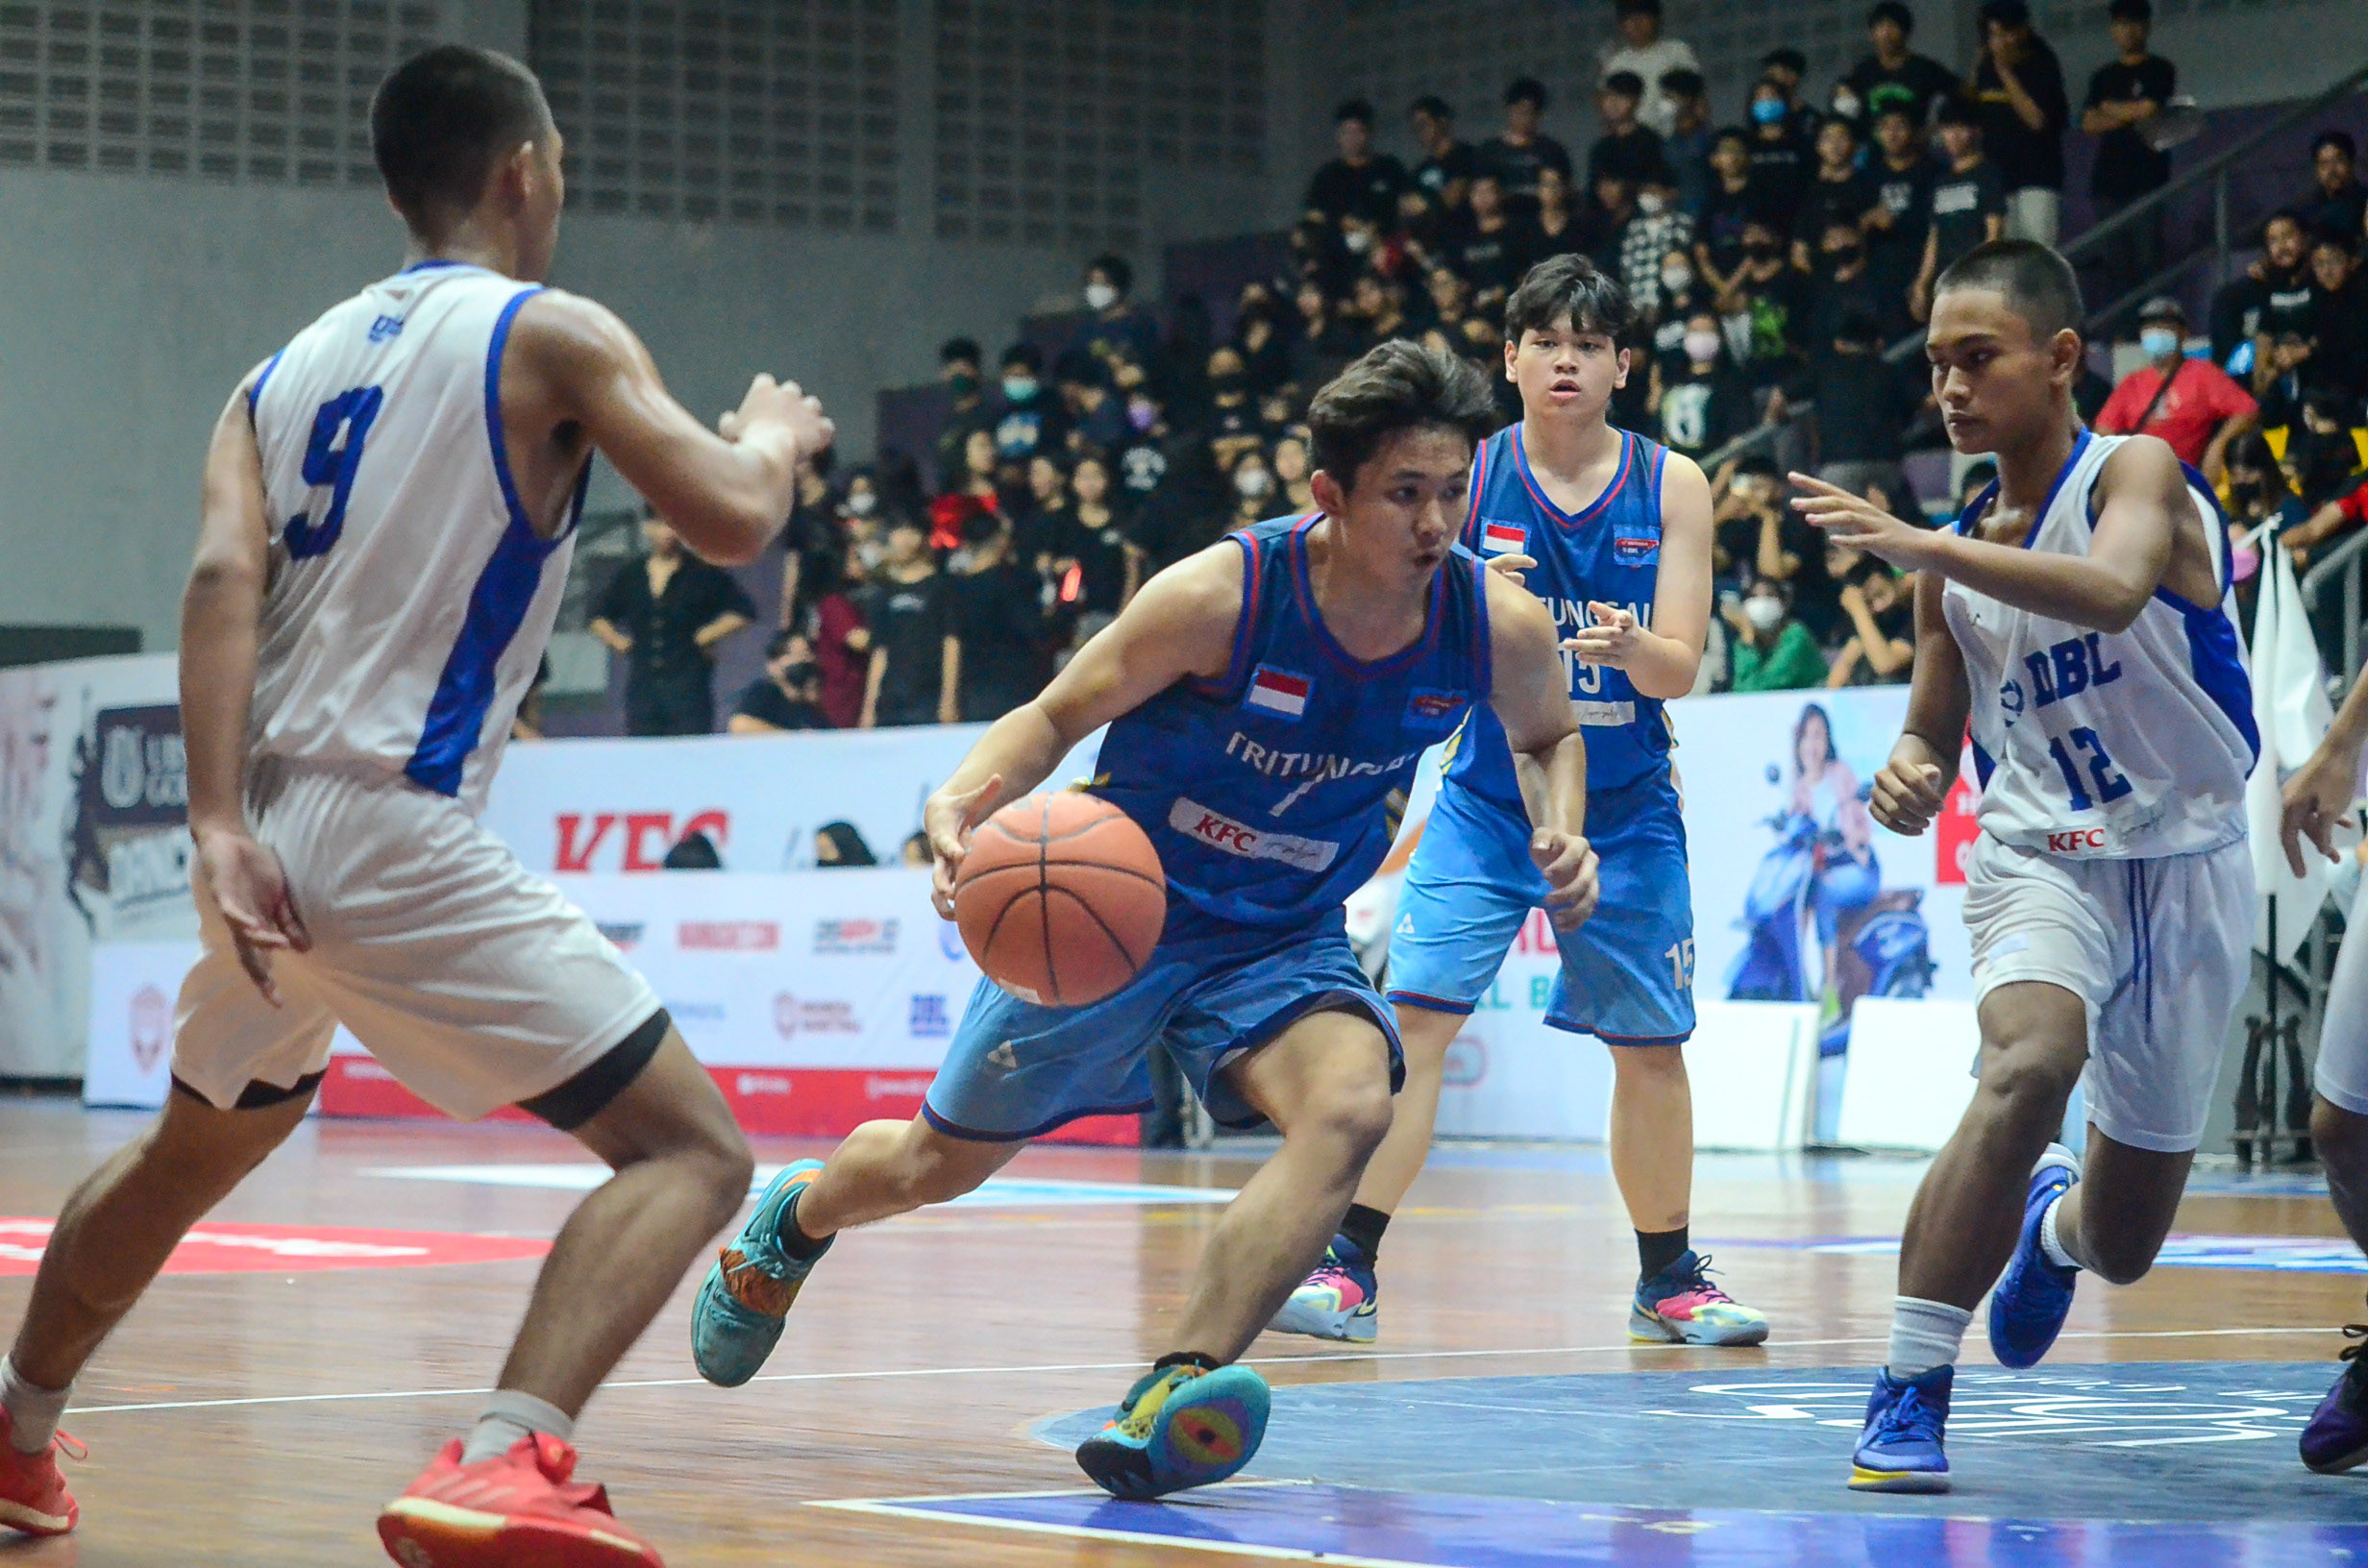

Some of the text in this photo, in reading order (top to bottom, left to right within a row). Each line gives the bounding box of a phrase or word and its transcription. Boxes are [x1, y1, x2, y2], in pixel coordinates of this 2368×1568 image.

[284, 385, 383, 562] 9
[2024, 632, 2122, 708] DBL
[2049, 725, 2134, 812] 12
[1194, 812, 1256, 852] KFC
[2047, 827, 2105, 853] KFC
[1665, 938, 1695, 991] 15
